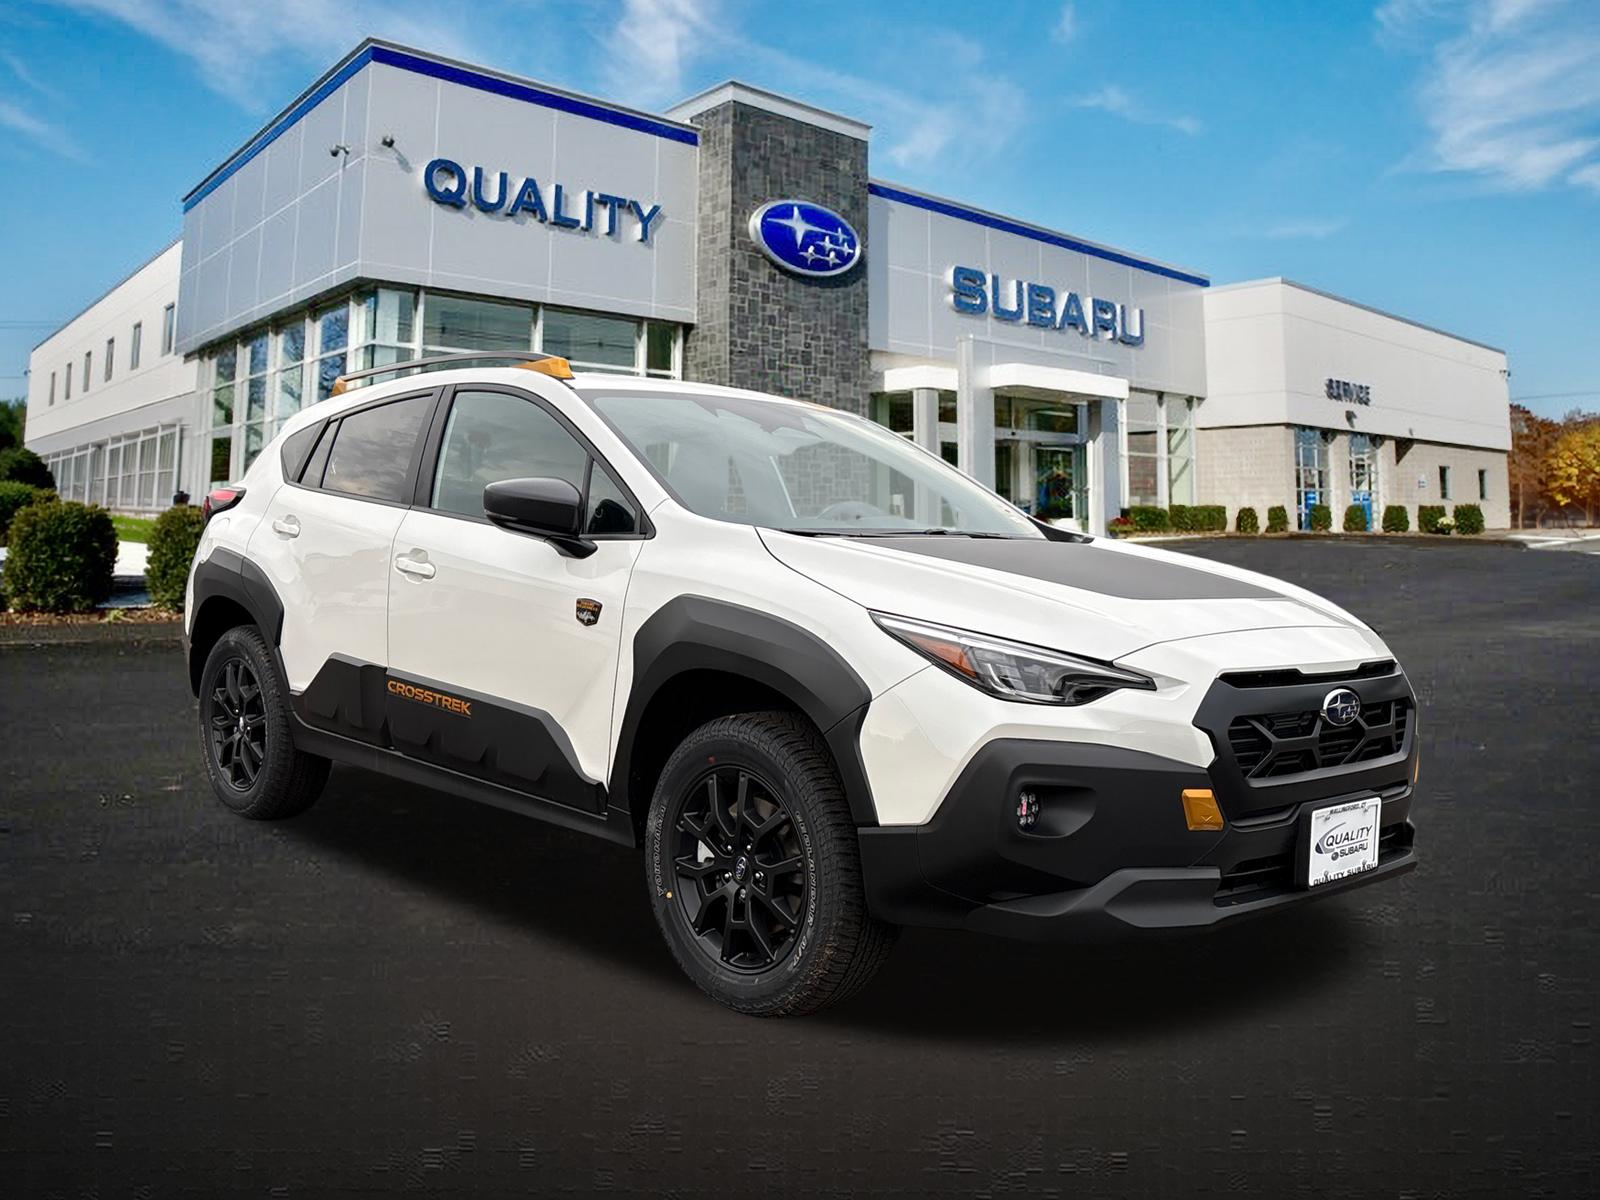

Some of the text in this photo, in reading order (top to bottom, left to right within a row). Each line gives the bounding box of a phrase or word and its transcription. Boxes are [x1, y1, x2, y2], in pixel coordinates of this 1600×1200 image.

[424, 158, 662, 243] QUALITY
[950, 265, 1145, 346] SUBARU
[1325, 378, 1371, 406] SERVICE
[387, 680, 471, 715] CROSSTREK
[653, 804, 667, 896] YOKOHAMA
[1326, 825, 1372, 847] QUALITY
[1340, 842, 1369, 858] SUBARU
[795, 810, 816, 926] GEOLANDAR
